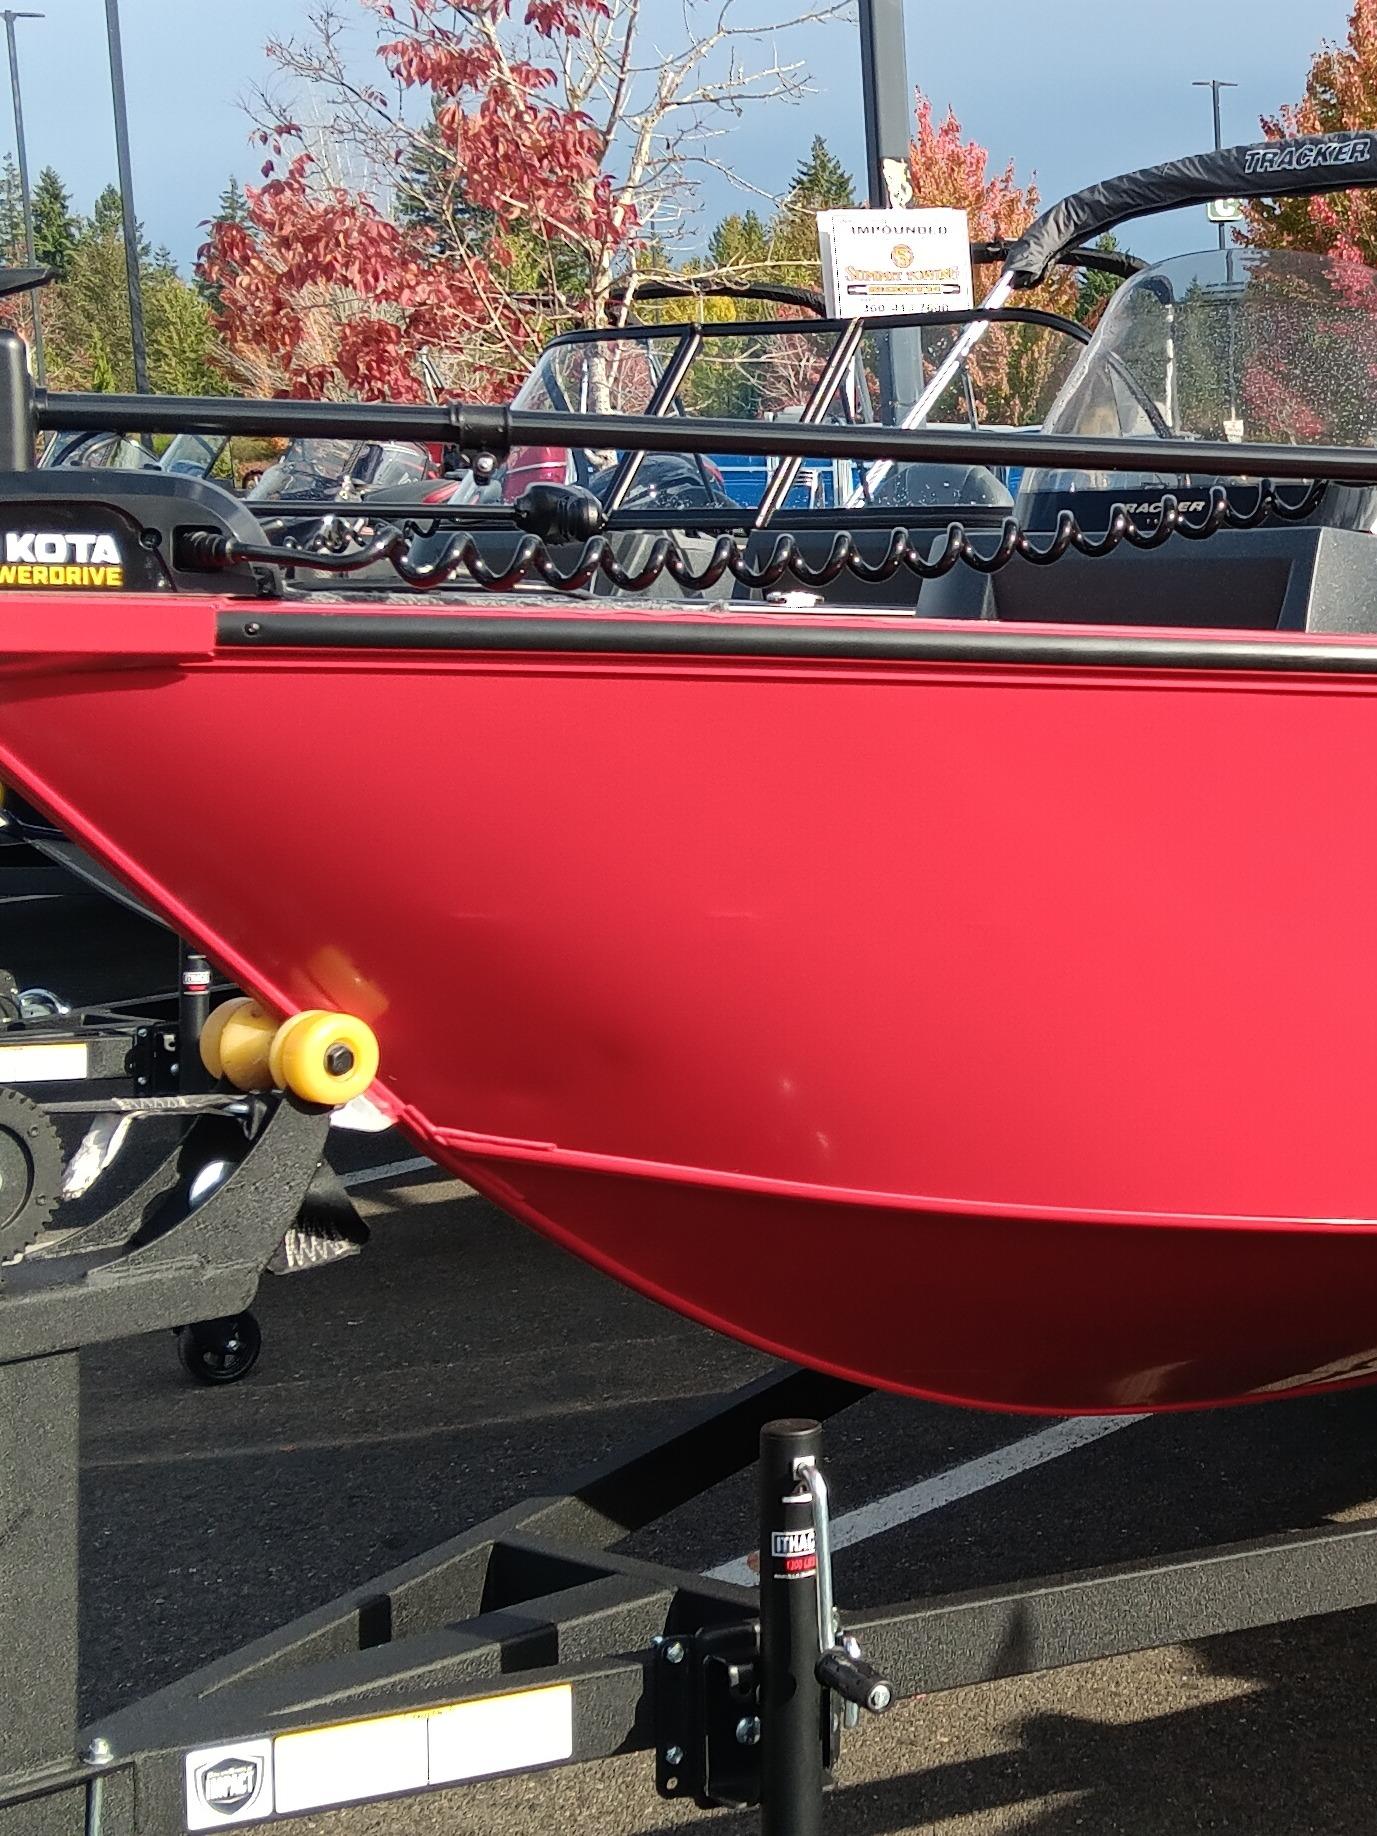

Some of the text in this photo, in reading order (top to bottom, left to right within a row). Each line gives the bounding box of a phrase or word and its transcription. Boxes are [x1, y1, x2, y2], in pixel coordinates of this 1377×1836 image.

[1244, 139, 1371, 174] TRACKER
[851, 225, 948, 235] IMPOUNDED
[5, 533, 121, 564] KOTA
